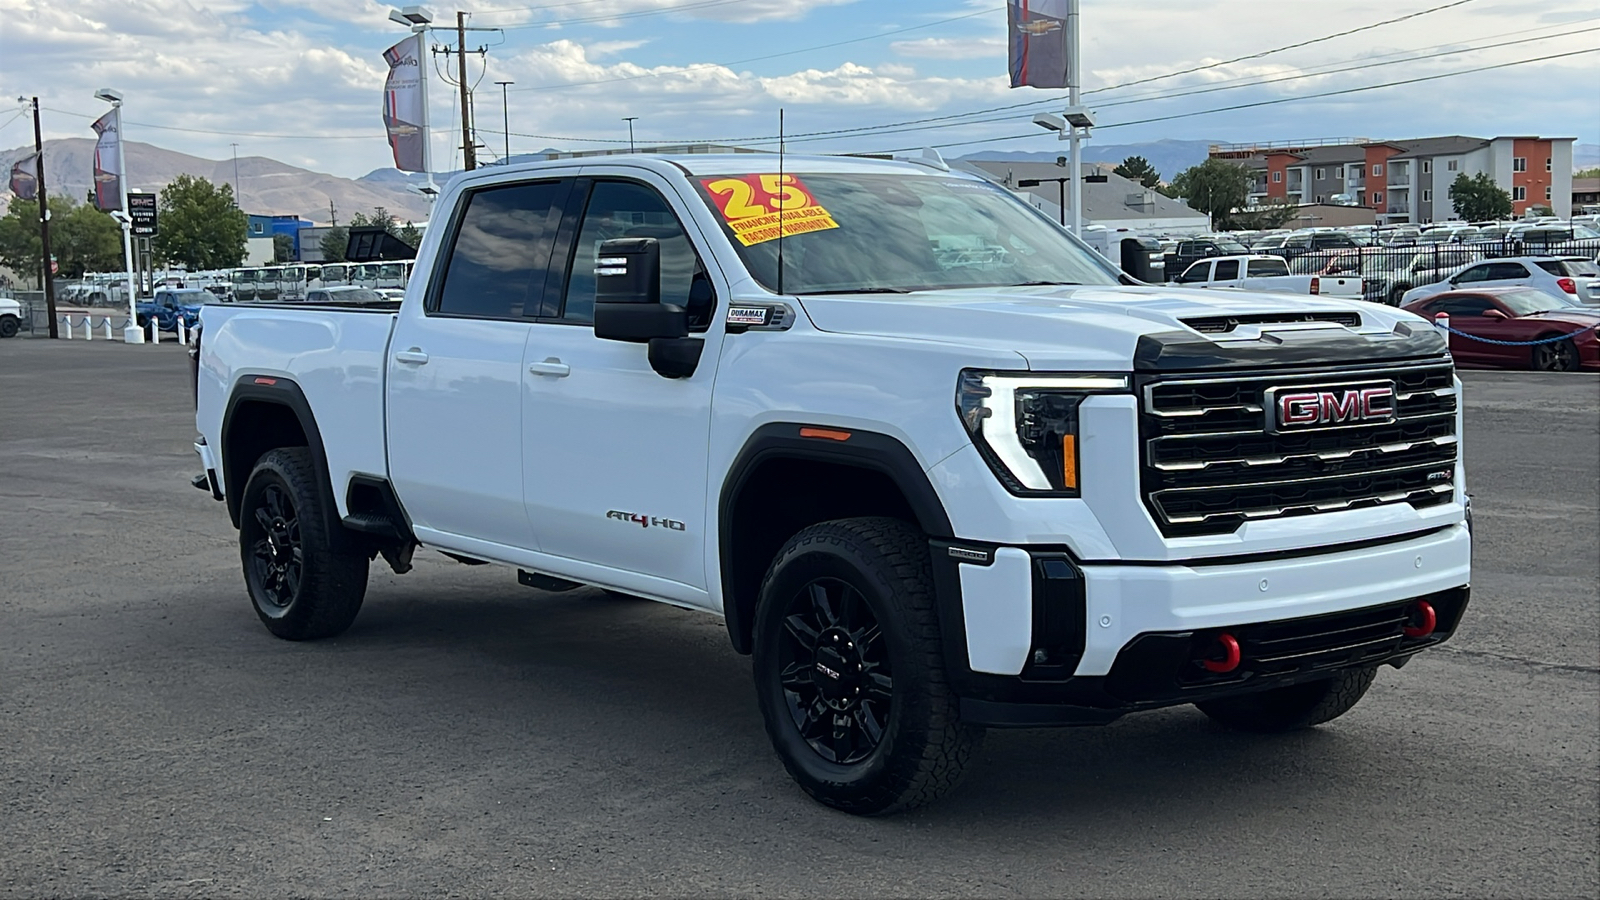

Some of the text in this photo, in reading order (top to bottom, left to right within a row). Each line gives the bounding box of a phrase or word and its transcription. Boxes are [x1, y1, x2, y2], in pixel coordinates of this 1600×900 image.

[131, 198, 154, 206] GMC
[708, 174, 812, 218] 25
[732, 208, 826, 232] FINANCING AVAILABLE
[742, 218, 833, 243] FACTORY WARRANTY
[730, 309, 764, 317] DURAMAX
[1279, 387, 1393, 426] GMC
[651, 516, 686, 531] HD
